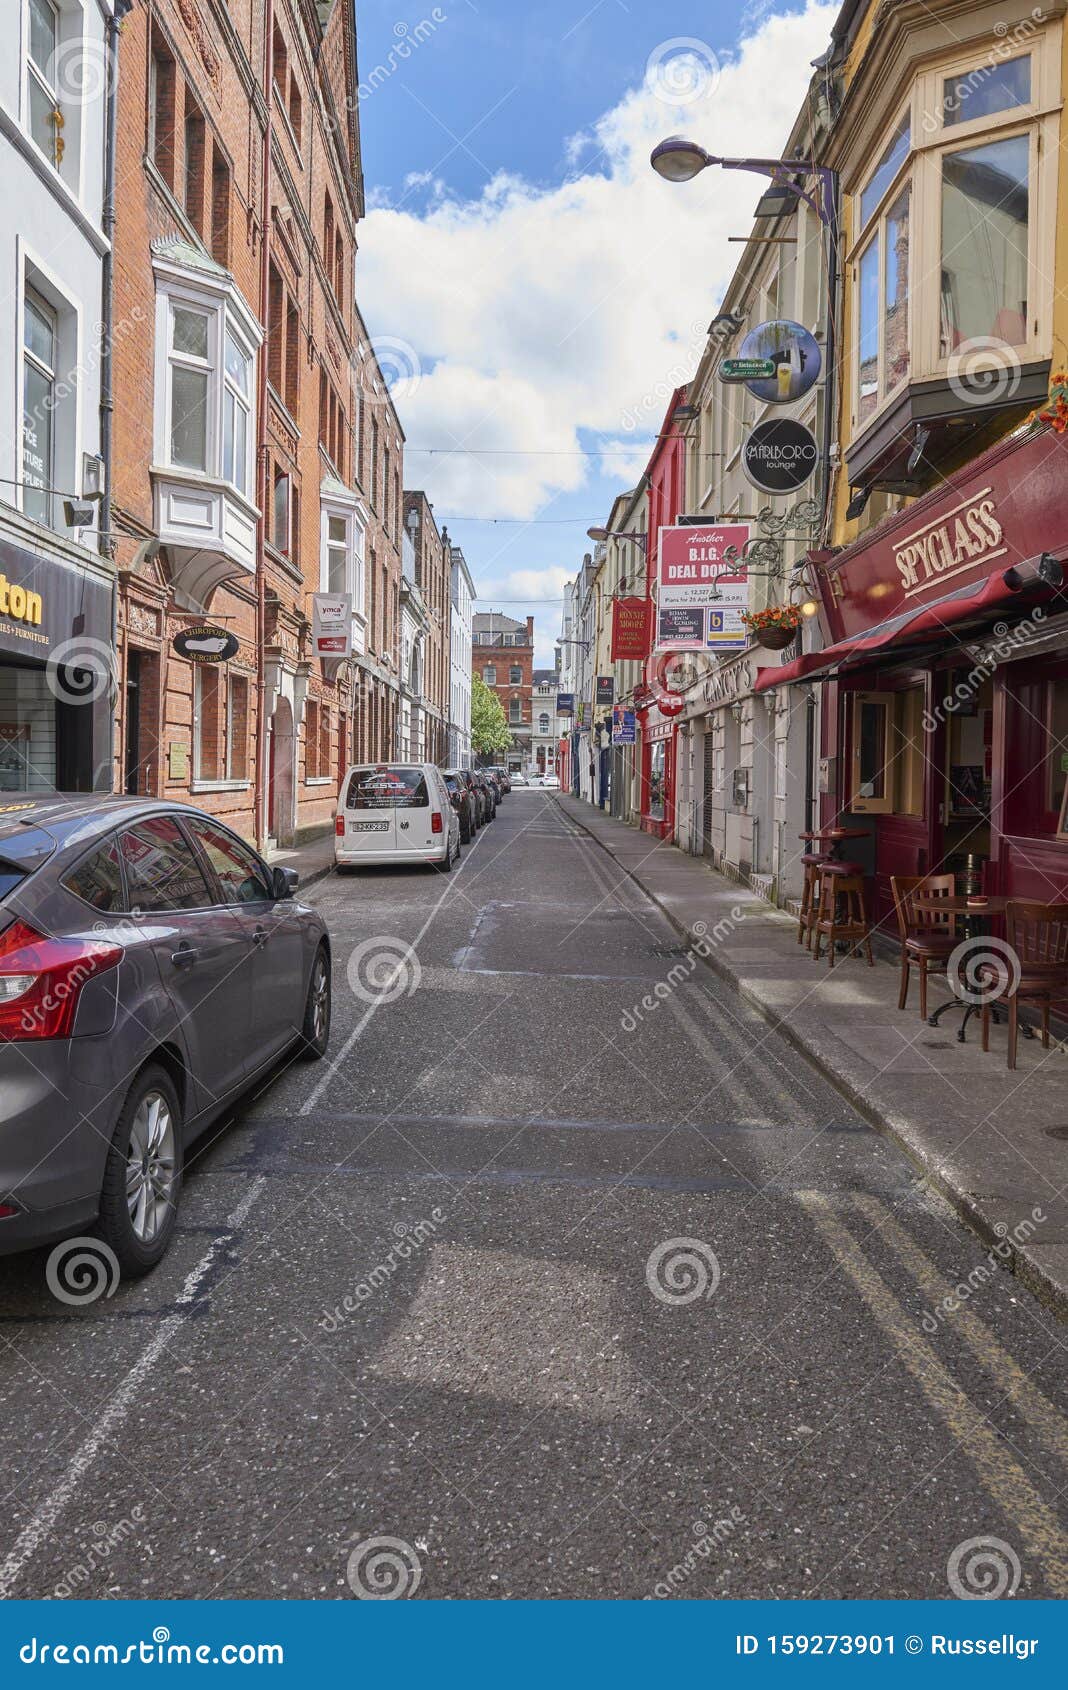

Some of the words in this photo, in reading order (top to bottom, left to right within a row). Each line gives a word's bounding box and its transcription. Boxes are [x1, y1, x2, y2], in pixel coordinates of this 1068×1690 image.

[747, 444, 816, 460] MARLBORO
[766, 461, 796, 470] lounge
[686, 532, 724, 544] Another
[895, 500, 1002, 590] SPYGLASS
[689, 547, 720, 562] B.I.G.
[668, 564, 698, 579] DEAL
[184, 627, 229, 638] CHIROPODY
[190, 652, 223, 662] SURGERY
